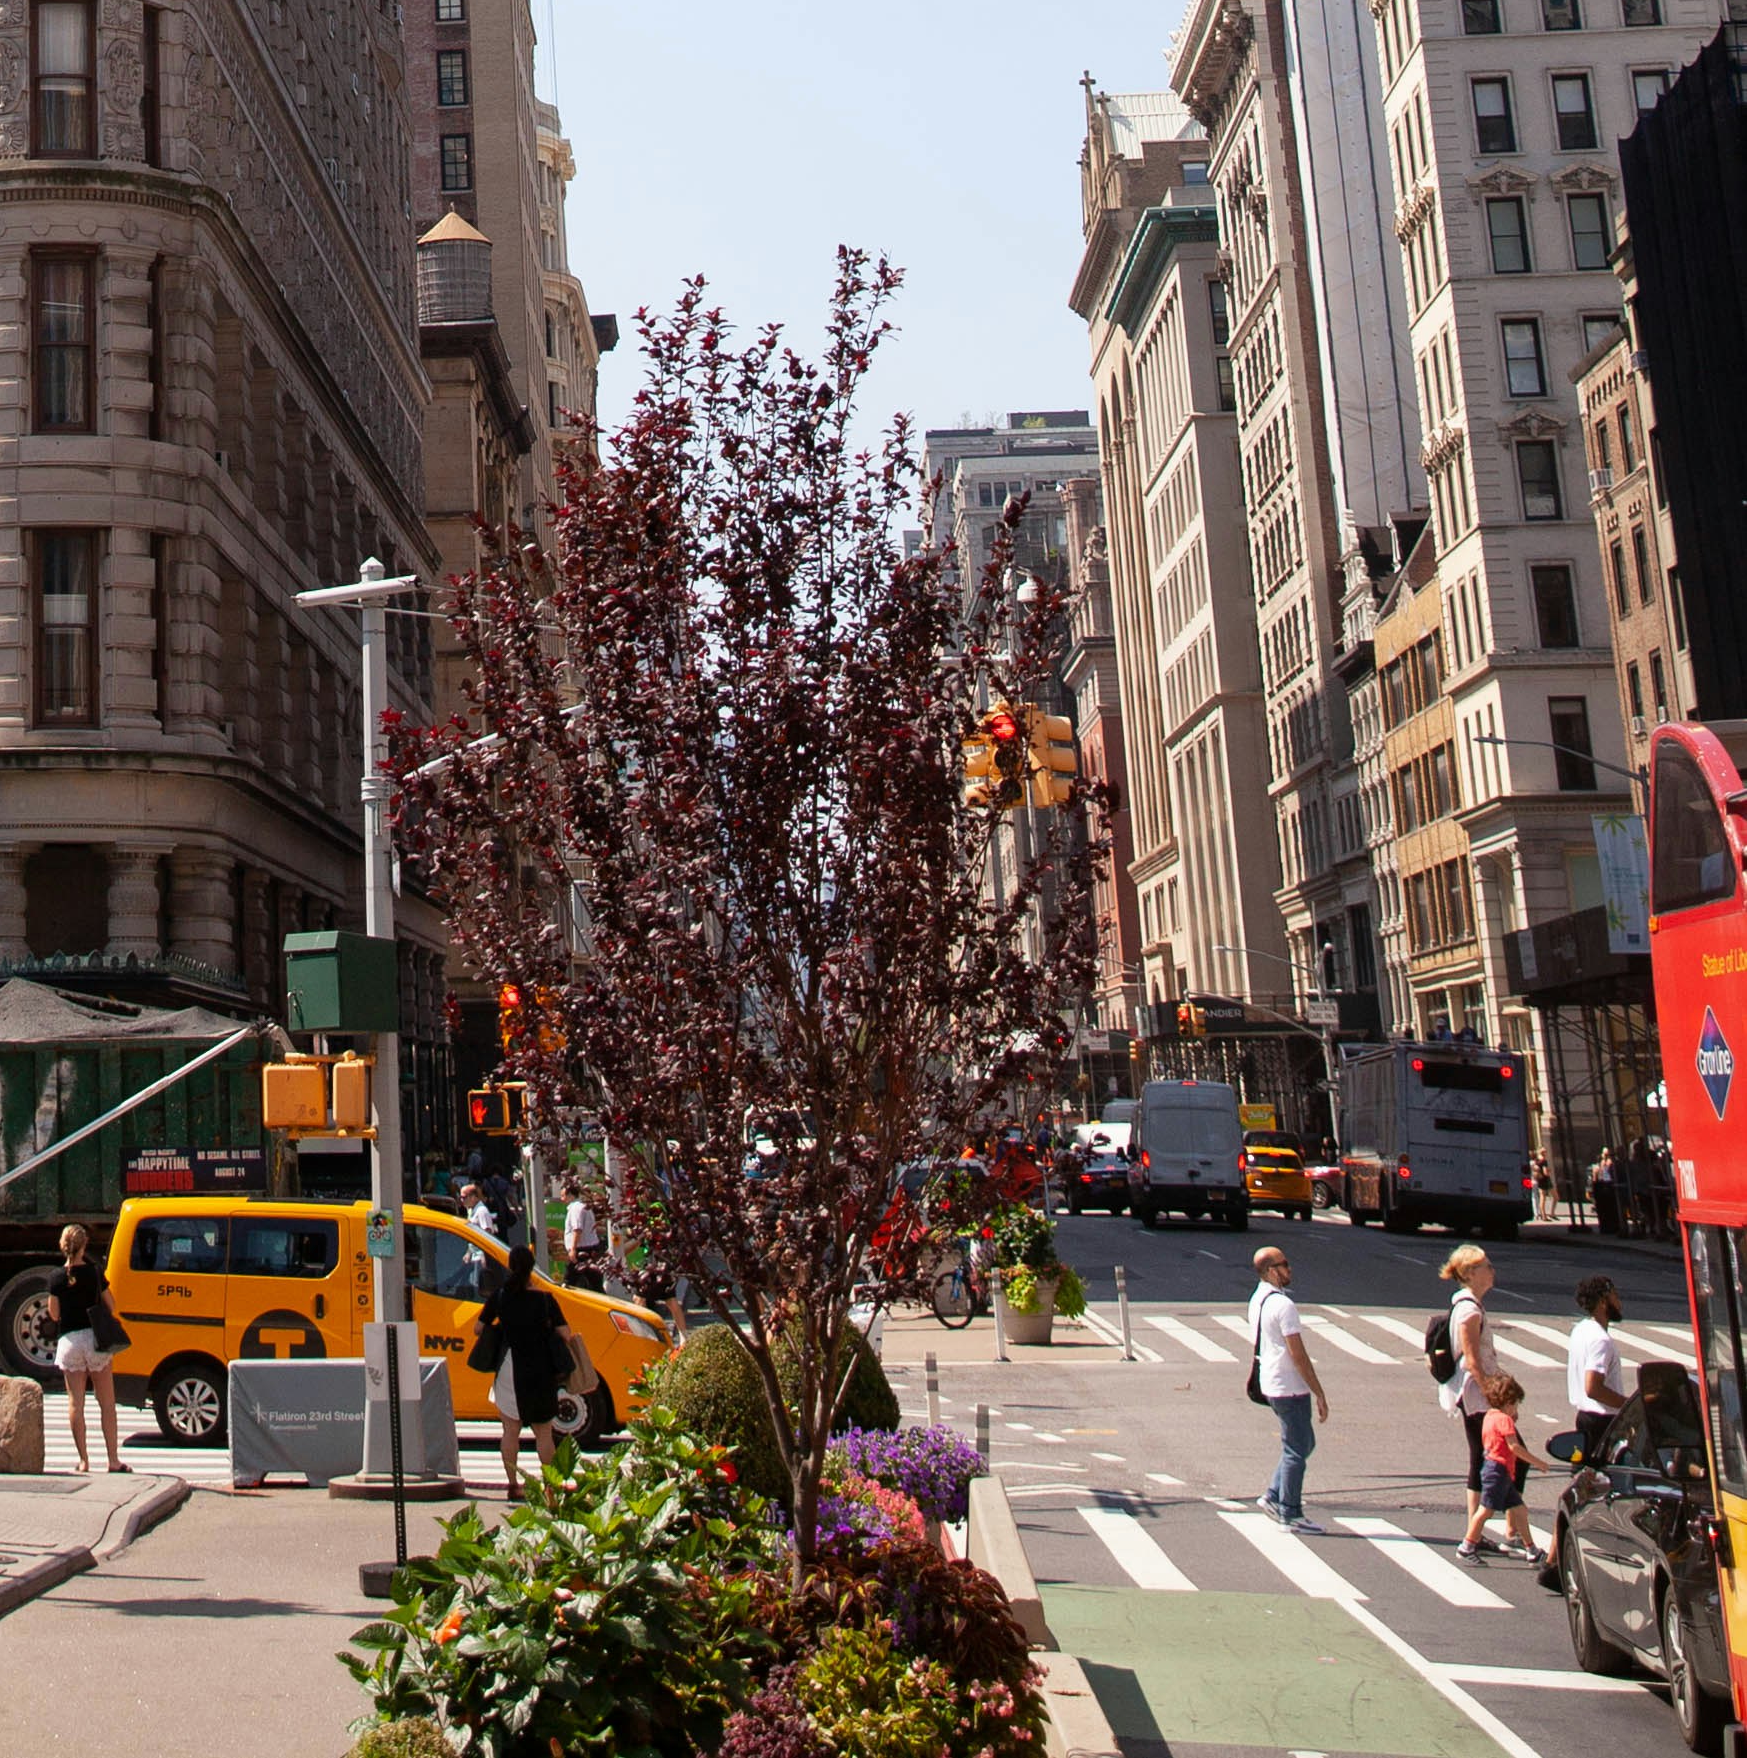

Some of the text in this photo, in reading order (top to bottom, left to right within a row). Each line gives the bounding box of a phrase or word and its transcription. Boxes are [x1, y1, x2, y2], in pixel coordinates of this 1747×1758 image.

[138, 1156, 190, 1171] HAPPYTIME
[215, 1167, 246, 1177] AUGUST 24
[424, 1334, 464, 1352] NYC
[269, 1411, 366, 1422] Flatiron 23rd Street
